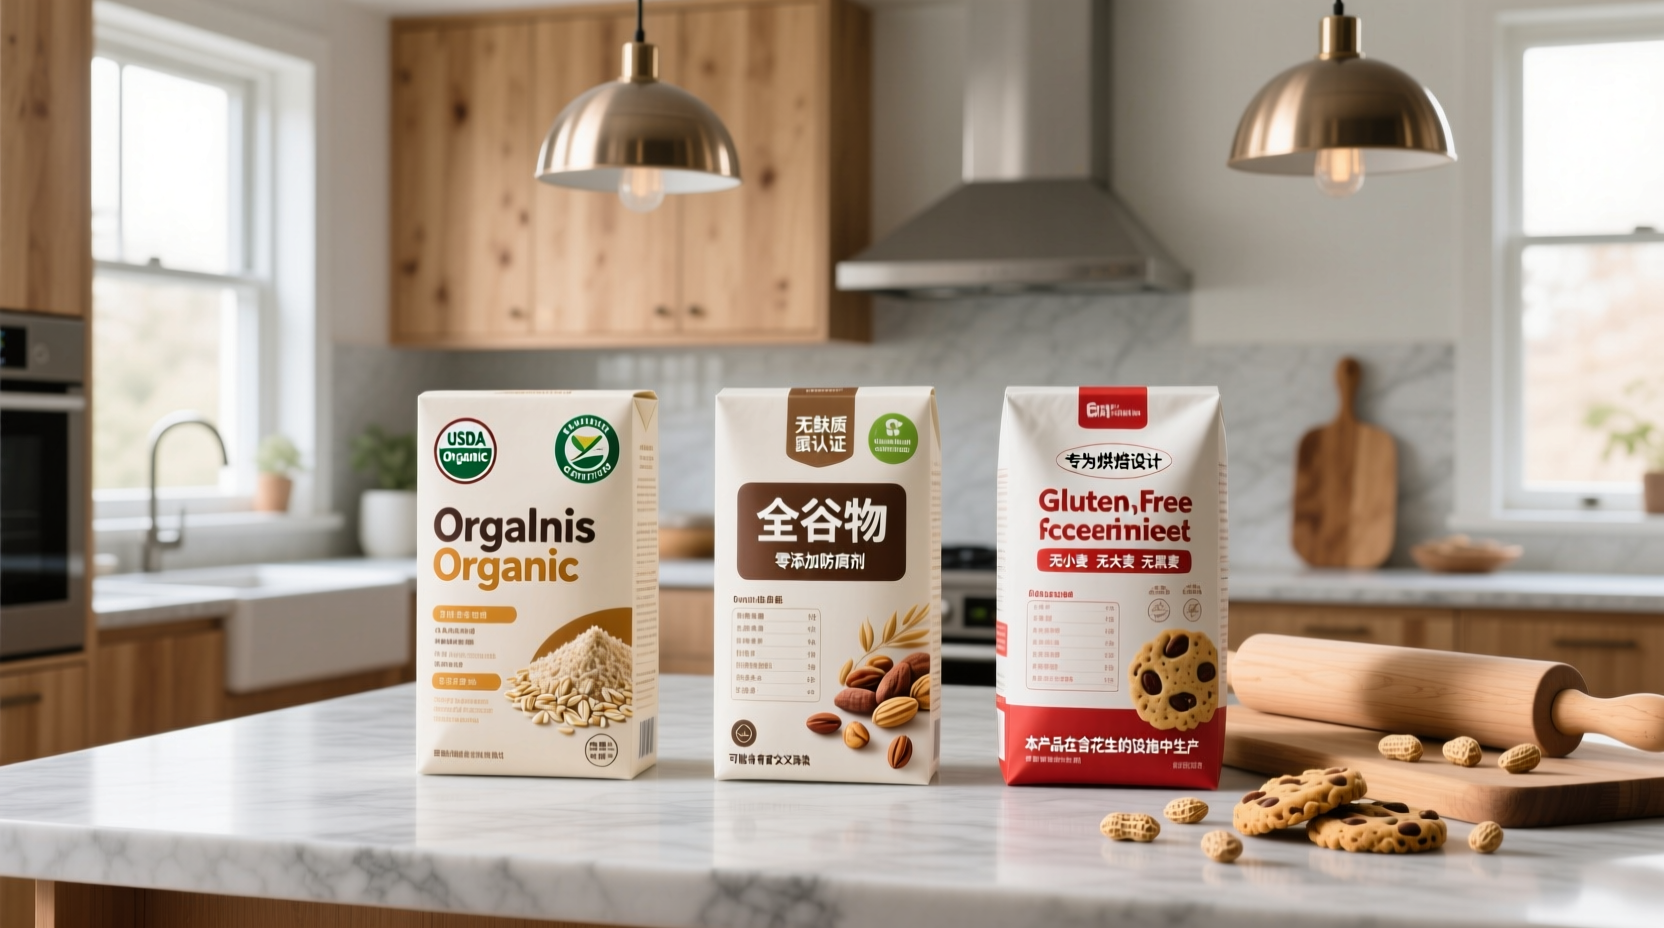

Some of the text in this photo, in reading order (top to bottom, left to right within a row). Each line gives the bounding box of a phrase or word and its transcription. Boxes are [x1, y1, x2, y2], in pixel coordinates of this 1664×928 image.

[447, 431, 487, 447] USDA
[442, 450, 489, 466] Organic
[1064, 451, 1163, 471] 专为烘焙设计
[433, 507, 596, 553] Orgalnis
[756, 497, 888, 544] 全谷物
[433, 547, 579, 591] Organic
